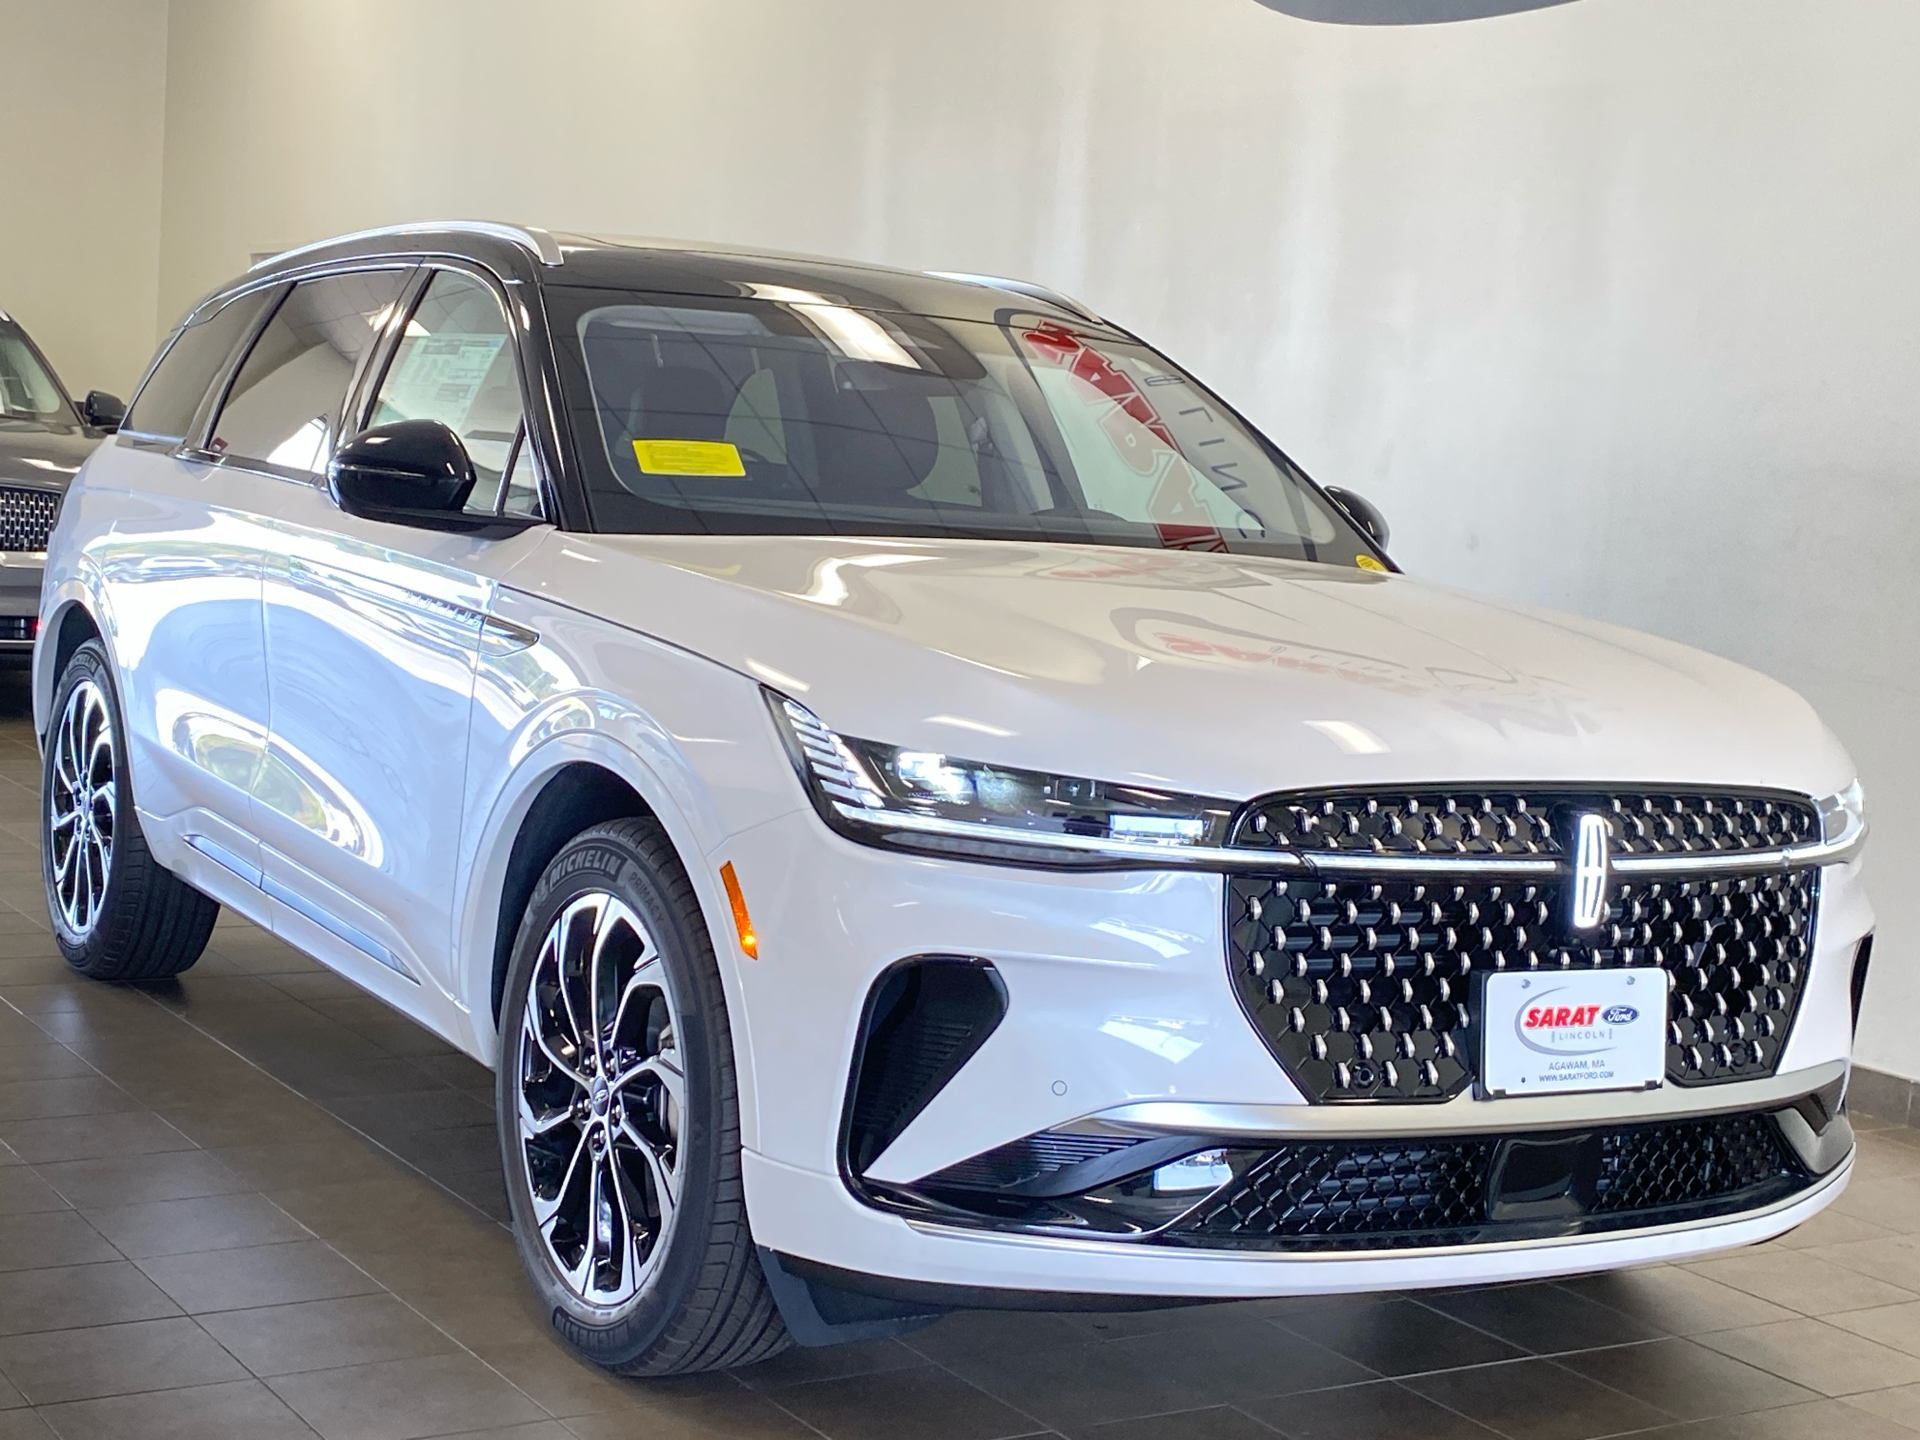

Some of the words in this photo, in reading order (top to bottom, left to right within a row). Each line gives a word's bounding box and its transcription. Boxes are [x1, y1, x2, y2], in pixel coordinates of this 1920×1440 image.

[550, 849, 622, 885] MICHELIN
[628, 871, 665, 924] PRIMACY
[1523, 1005, 1600, 1028] SARAT
[1606, 1007, 1634, 1023] Ford
[1559, 1031, 1605, 1041] LINCOLN
[1548, 1060, 1590, 1071] AGAWAM,
[1591, 1060, 1605, 1068] MA
[1539, 1071, 1614, 1082] WWW.SARATFORD.COM
